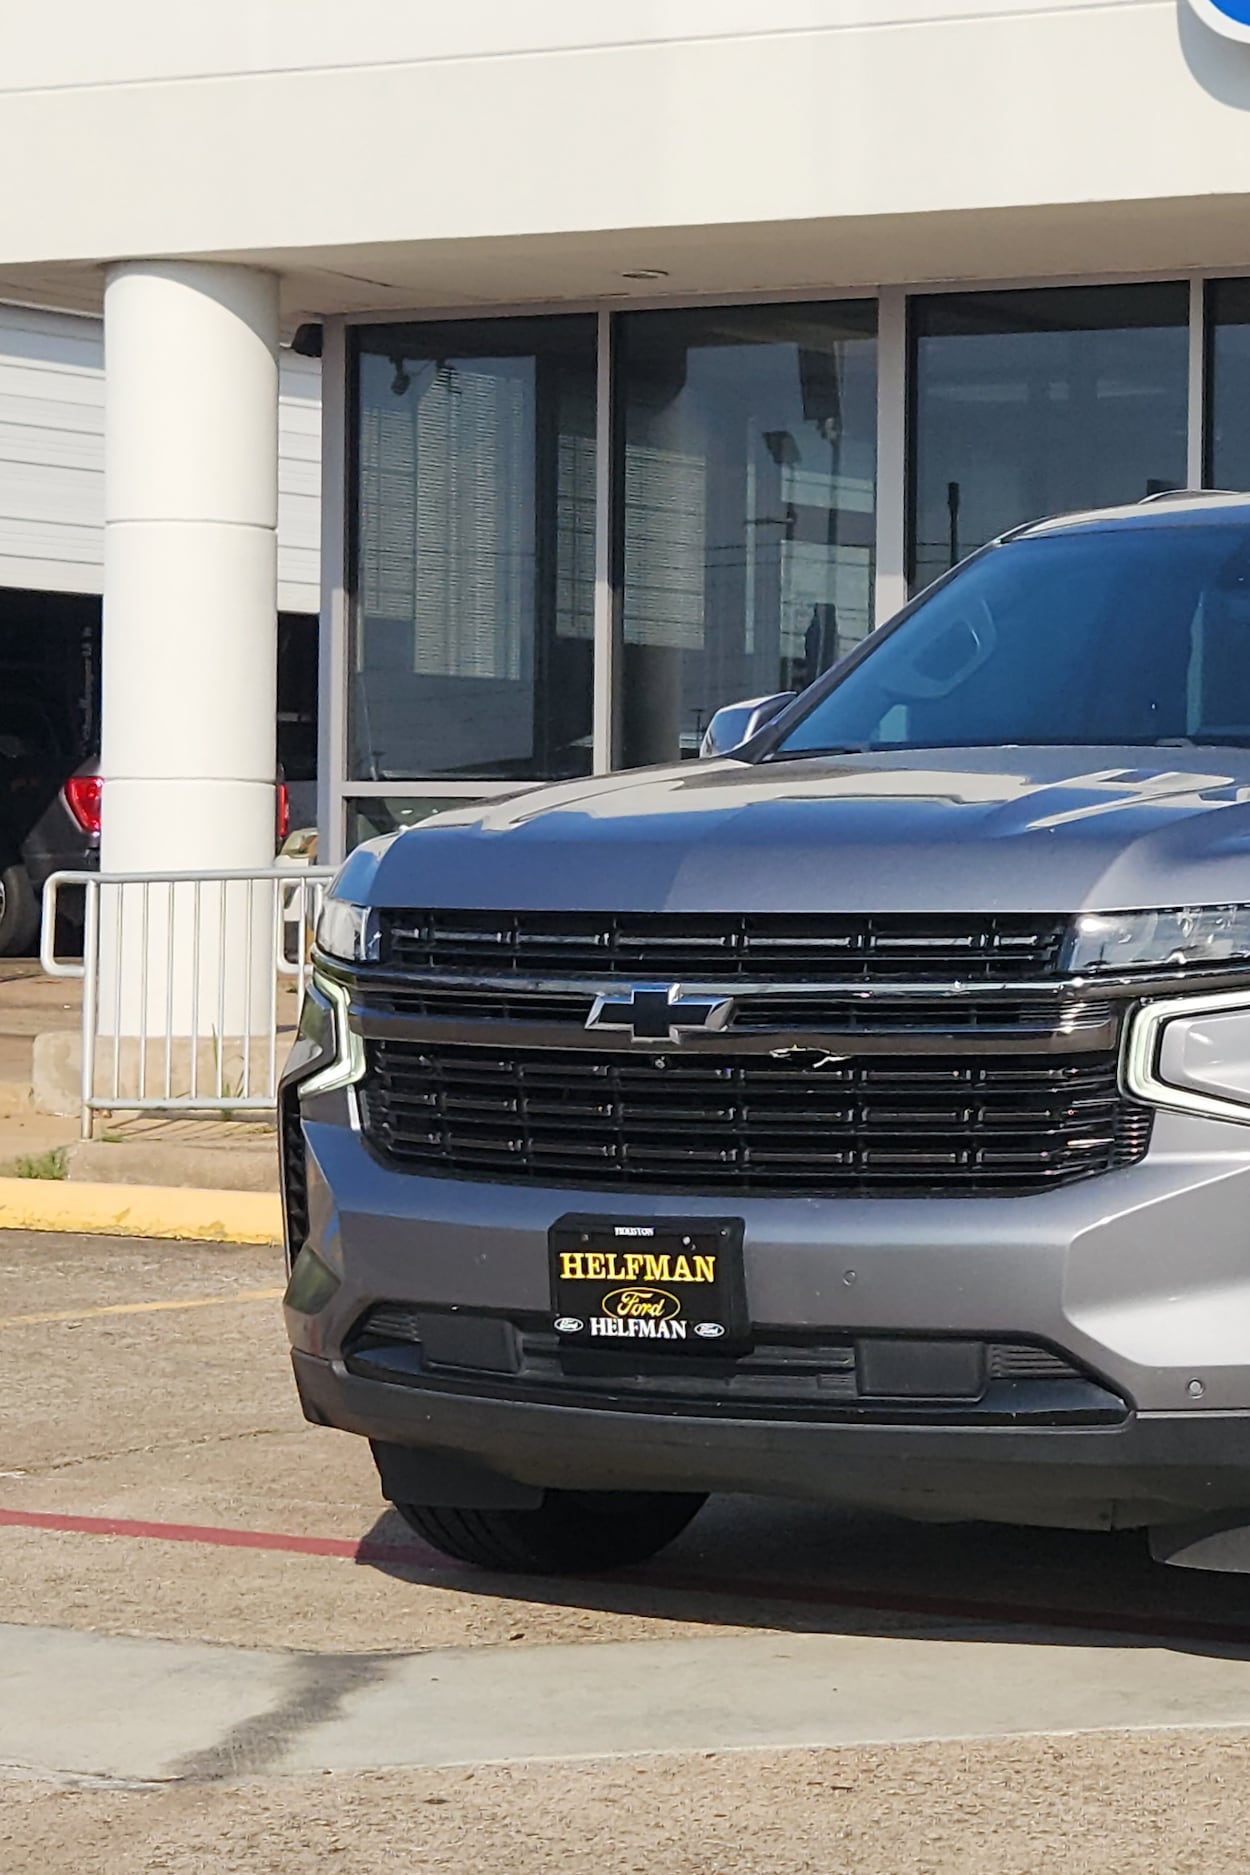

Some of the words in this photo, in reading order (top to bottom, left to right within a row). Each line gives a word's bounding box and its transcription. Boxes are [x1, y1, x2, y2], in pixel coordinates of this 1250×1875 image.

[559, 1252, 716, 1283] HELFMAN
[616, 1291, 665, 1317] Ford
[589, 1317, 688, 1340] HELFMAN
